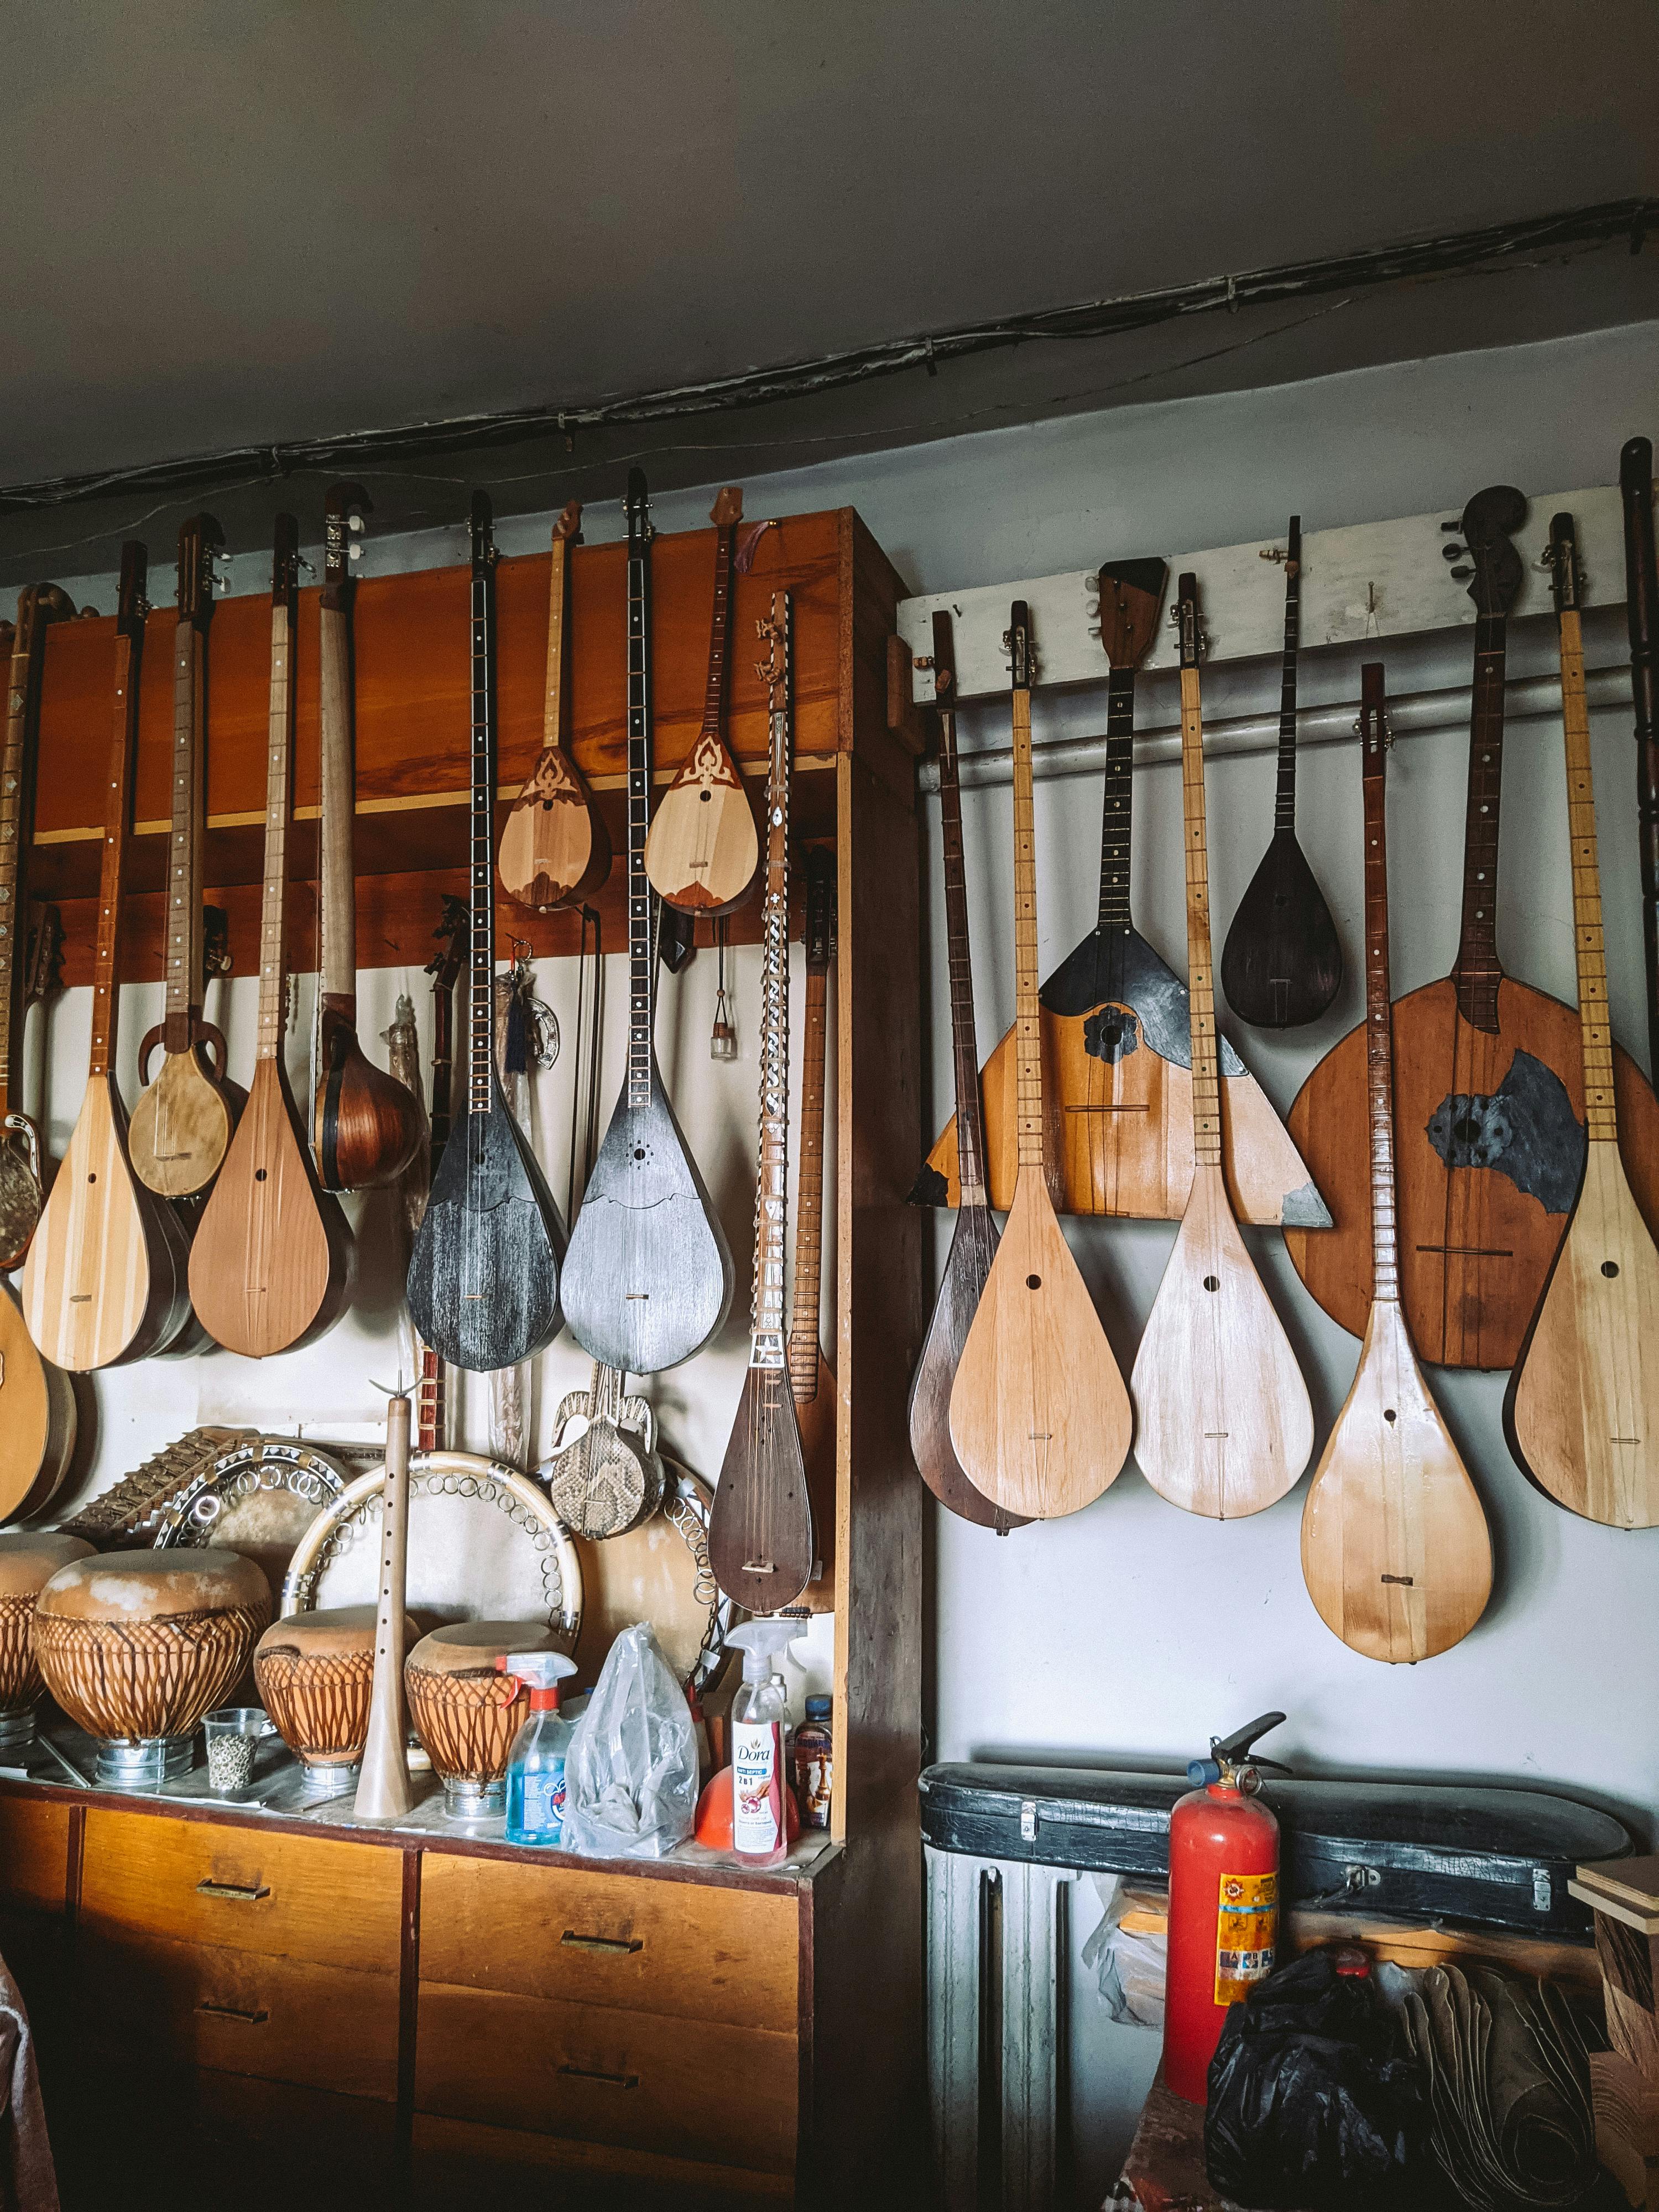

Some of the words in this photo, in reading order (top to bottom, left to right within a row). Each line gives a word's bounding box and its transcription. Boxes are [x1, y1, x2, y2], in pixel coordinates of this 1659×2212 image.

[738, 1745, 770, 1761] Dora
[739, 1776, 742, 1784] 2
[749, 1777, 753, 1785] 1
